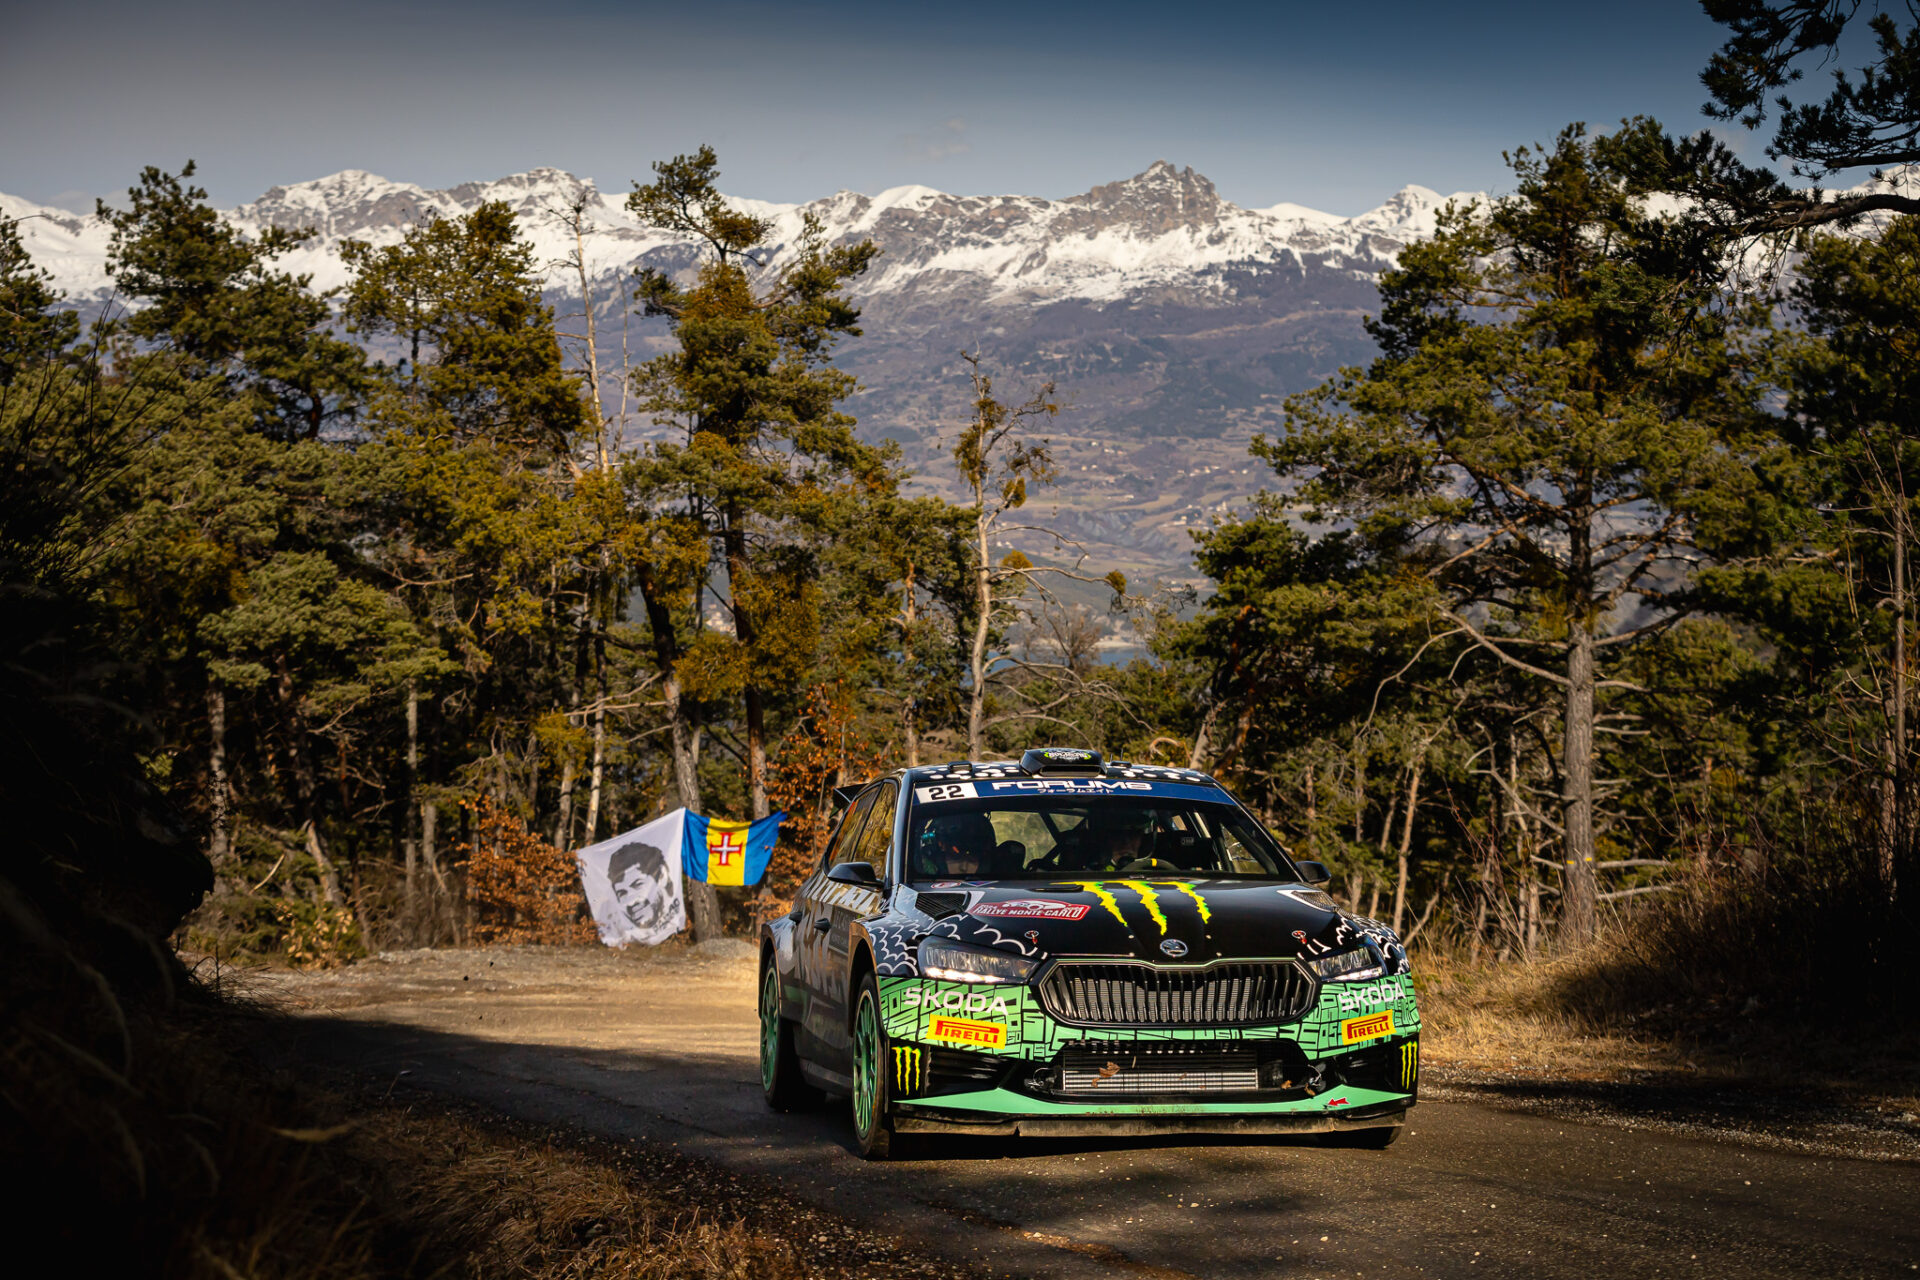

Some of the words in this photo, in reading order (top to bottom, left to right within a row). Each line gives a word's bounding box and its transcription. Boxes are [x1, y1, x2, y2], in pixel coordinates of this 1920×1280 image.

[928, 785, 964, 800] 22
[991, 780, 1152, 791] FORUM8
[973, 905, 1006, 915] RALLYE
[934, 1019, 1000, 1044] PIRELLI
[1346, 1015, 1390, 1039] PIRELLI
